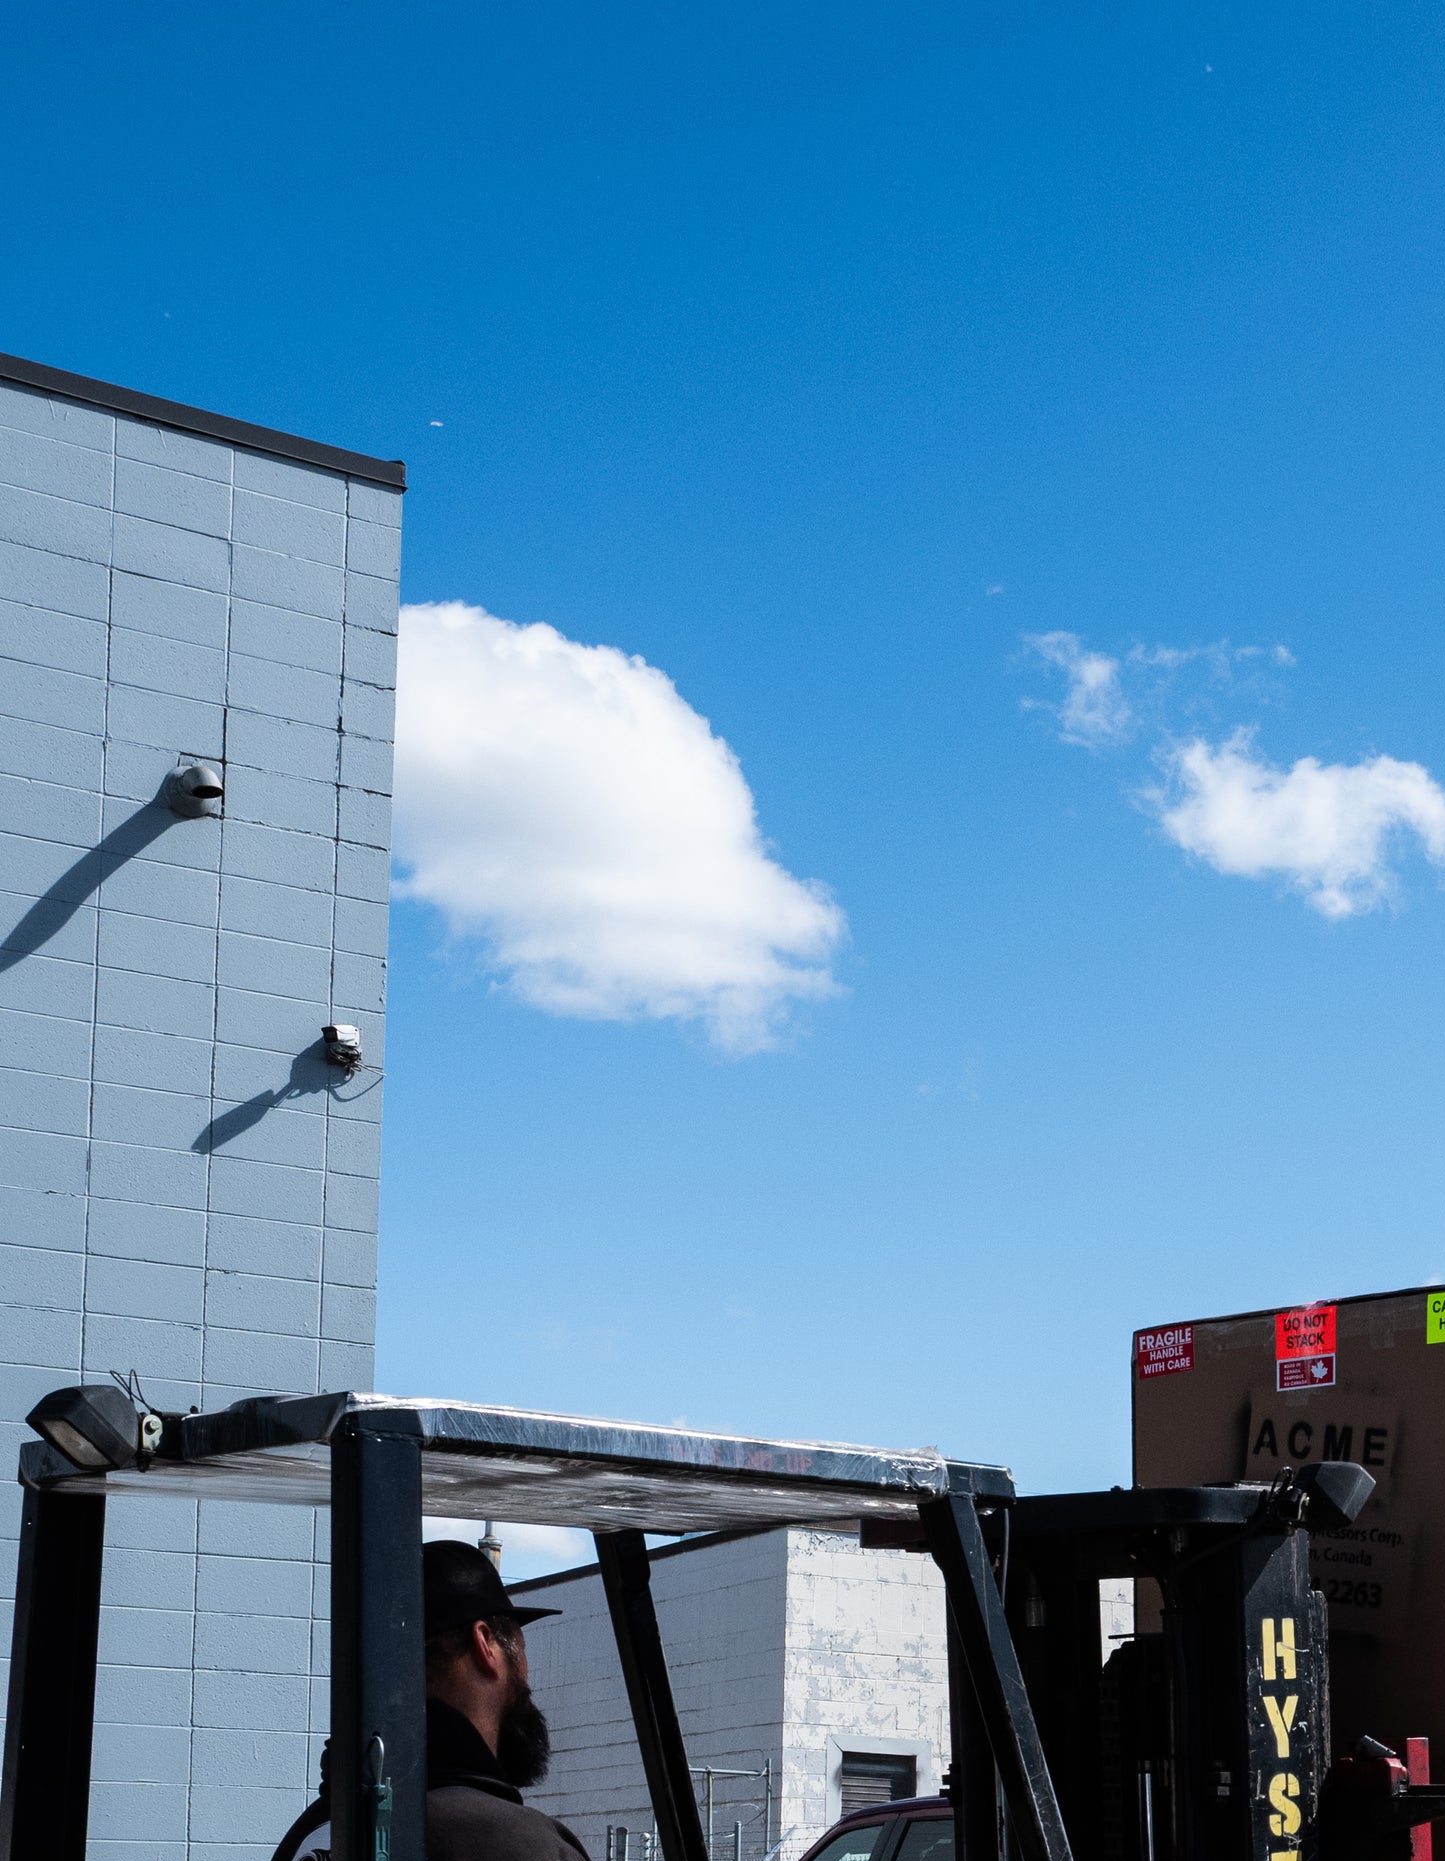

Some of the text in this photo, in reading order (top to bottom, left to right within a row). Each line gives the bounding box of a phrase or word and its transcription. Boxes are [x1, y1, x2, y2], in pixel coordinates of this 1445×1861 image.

[1283, 1314, 1328, 1332] DO NOT
[1139, 1327, 1191, 1351] FRAGILE
[1286, 1332, 1325, 1349] STACK
[1149, 1345, 1183, 1361] HANDLE
[1143, 1357, 1190, 1375] WITH CARE
[1252, 1418, 1388, 1466] ACME
[1369, 1528, 1405, 1547] Corp.
[1323, 1547, 1372, 1566] Canada
[1327, 1579, 1382, 1608] 2263
